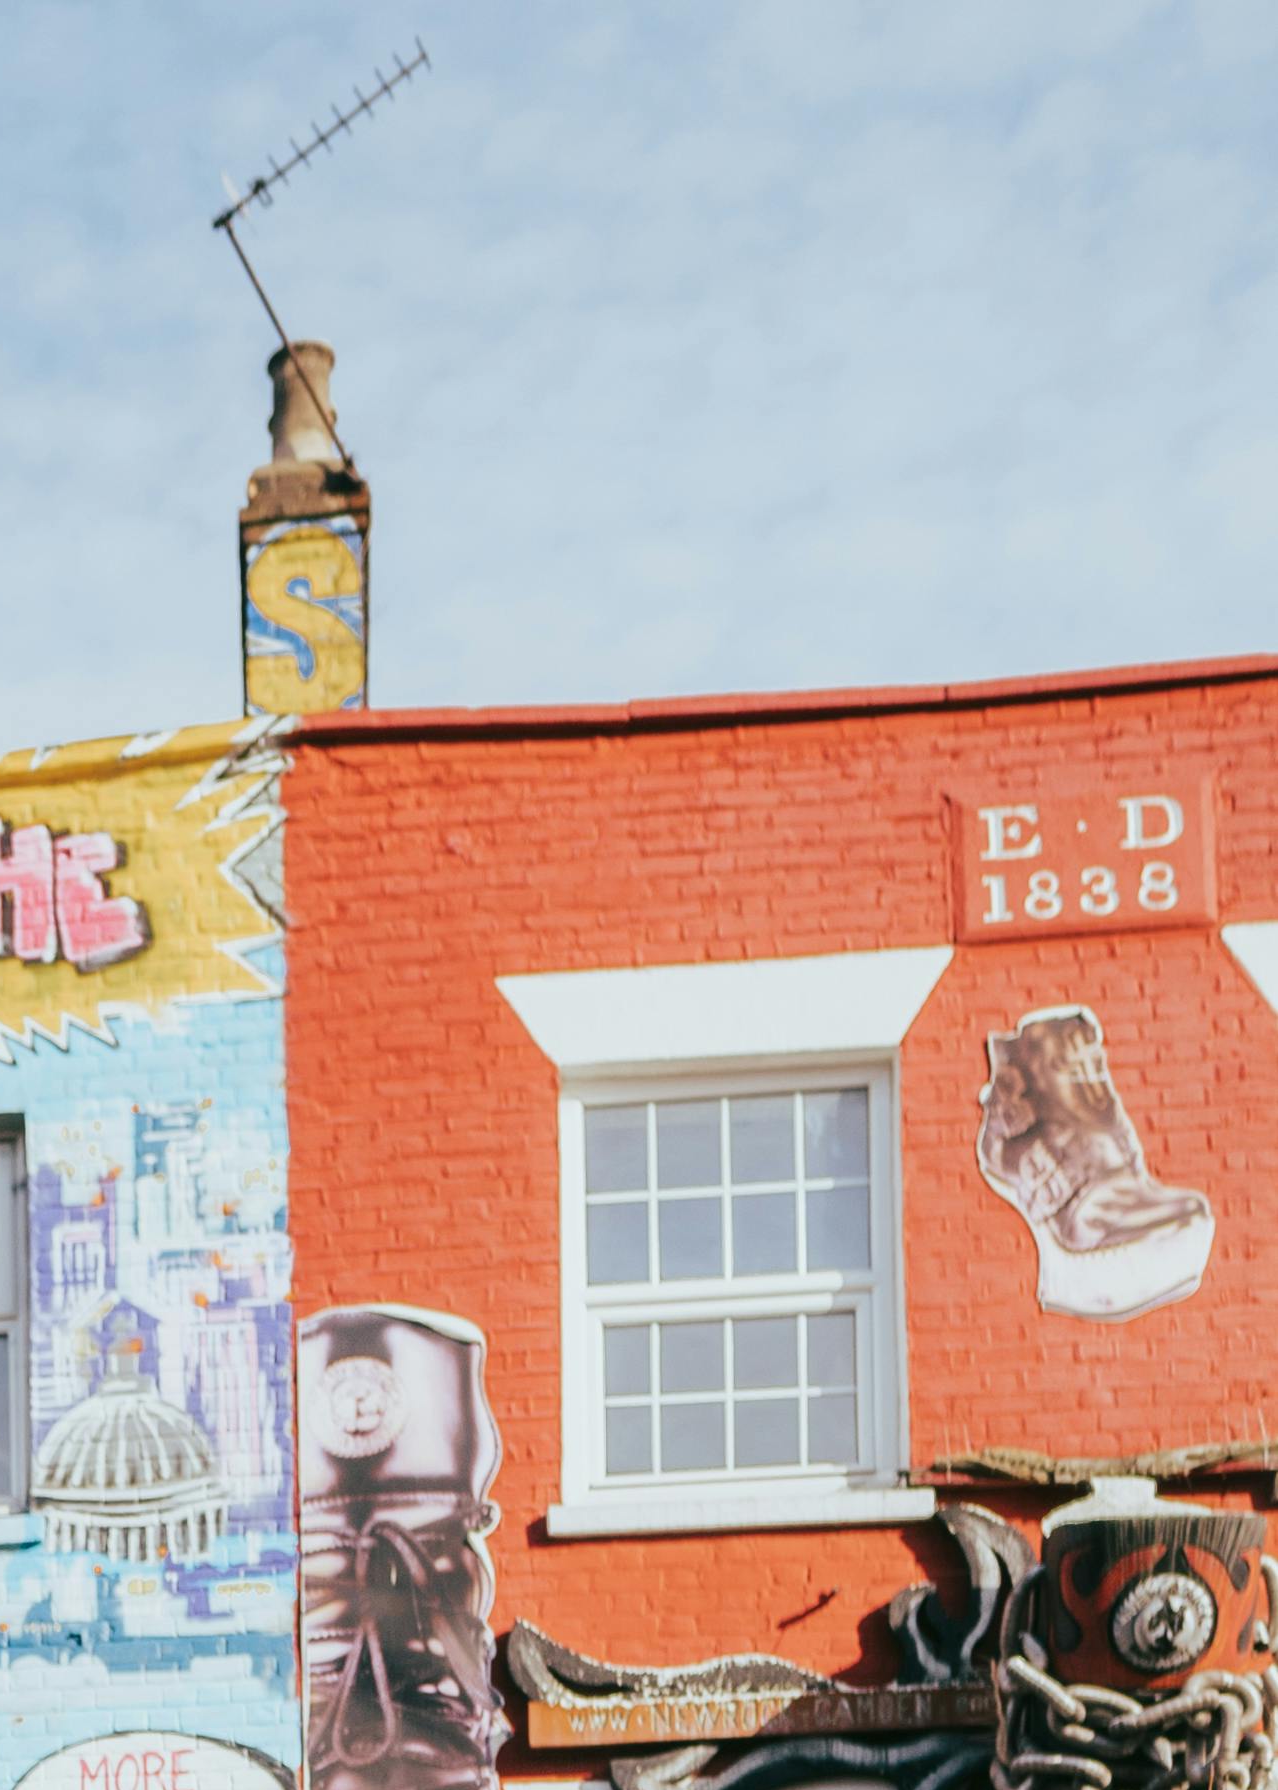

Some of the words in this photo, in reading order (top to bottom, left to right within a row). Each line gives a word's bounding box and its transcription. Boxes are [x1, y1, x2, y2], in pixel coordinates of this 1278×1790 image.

[978, 806, 1042, 862] E
[1119, 796, 1184, 850] D
[981, 861, 1179, 924] 1838
